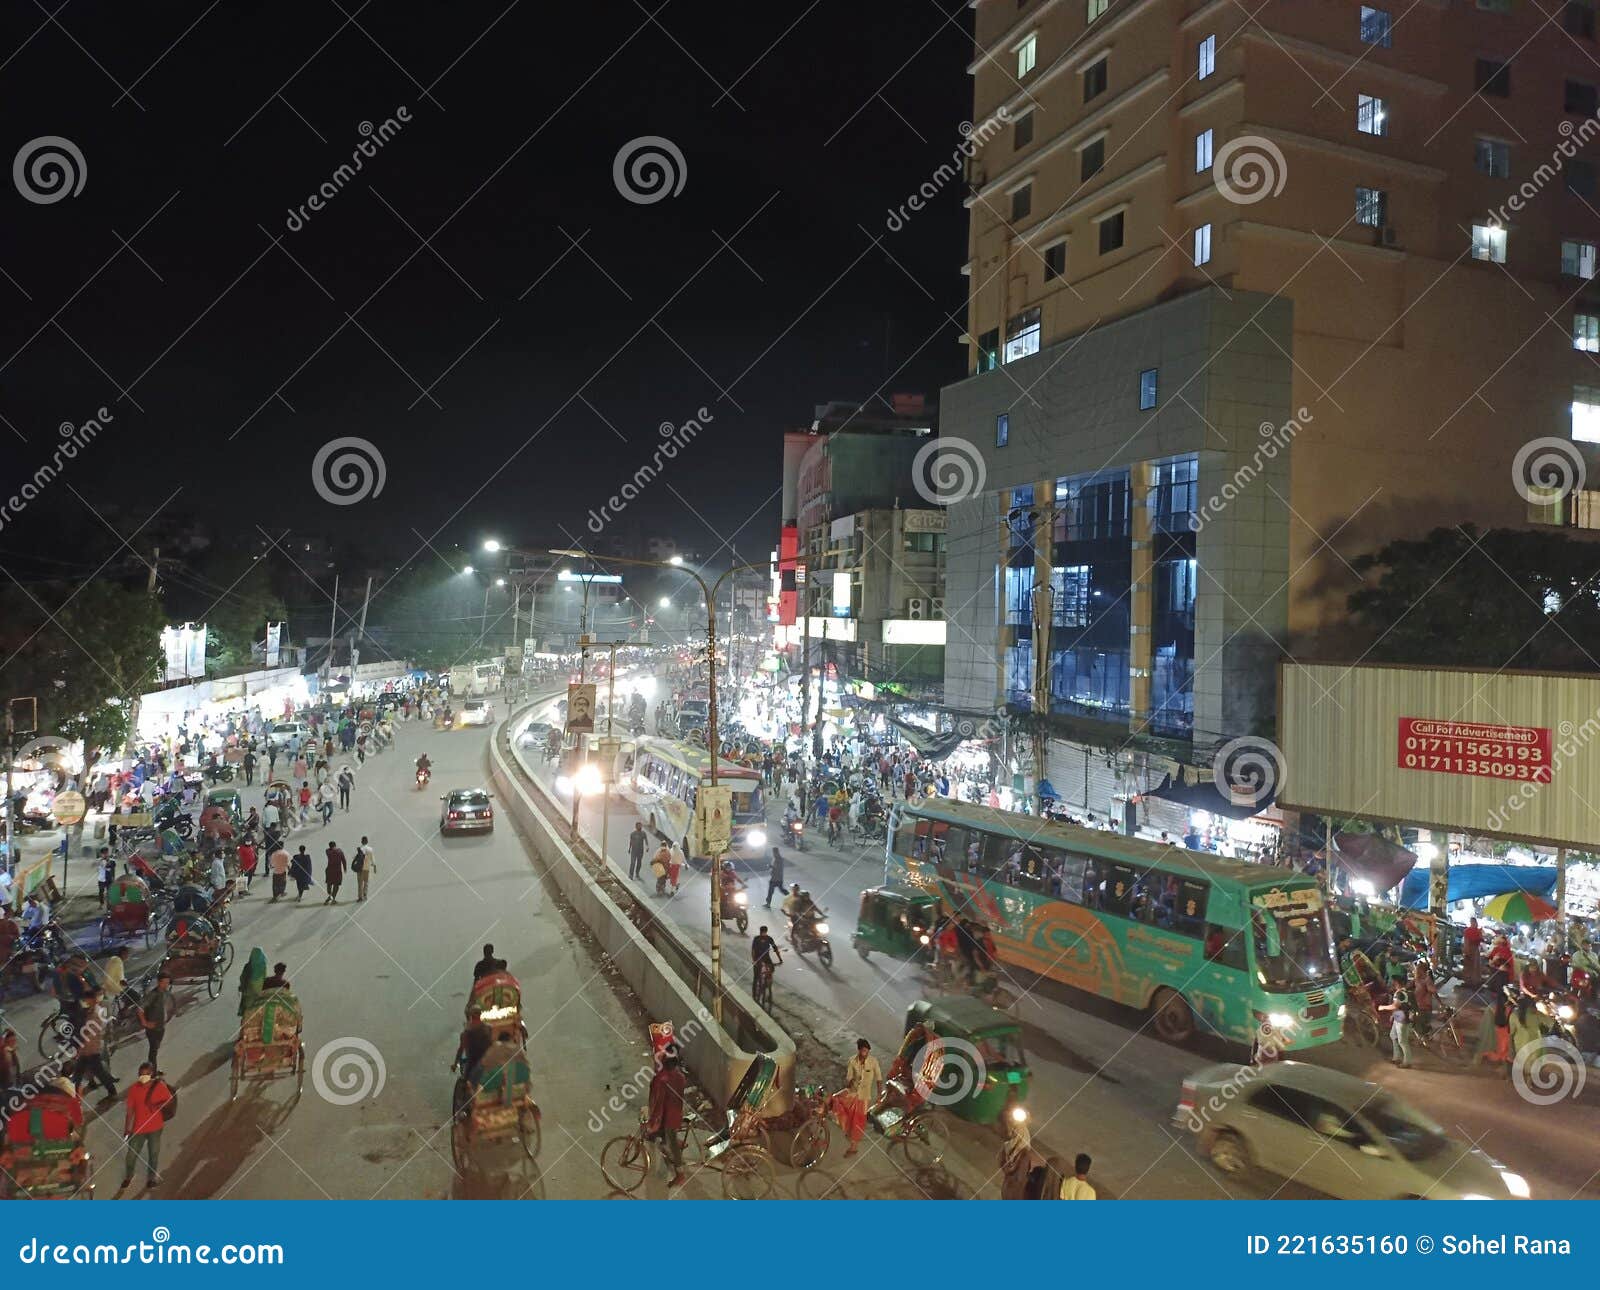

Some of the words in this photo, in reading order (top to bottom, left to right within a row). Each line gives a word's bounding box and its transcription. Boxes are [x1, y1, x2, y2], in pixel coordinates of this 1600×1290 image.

[1415, 723, 1434, 733] Call
[1436, 724, 1452, 735] For
[1454, 727, 1532, 741] Advertisement
[1405, 736, 1543, 762] 01711562193
[1405, 753, 1544, 780] 01711350937
